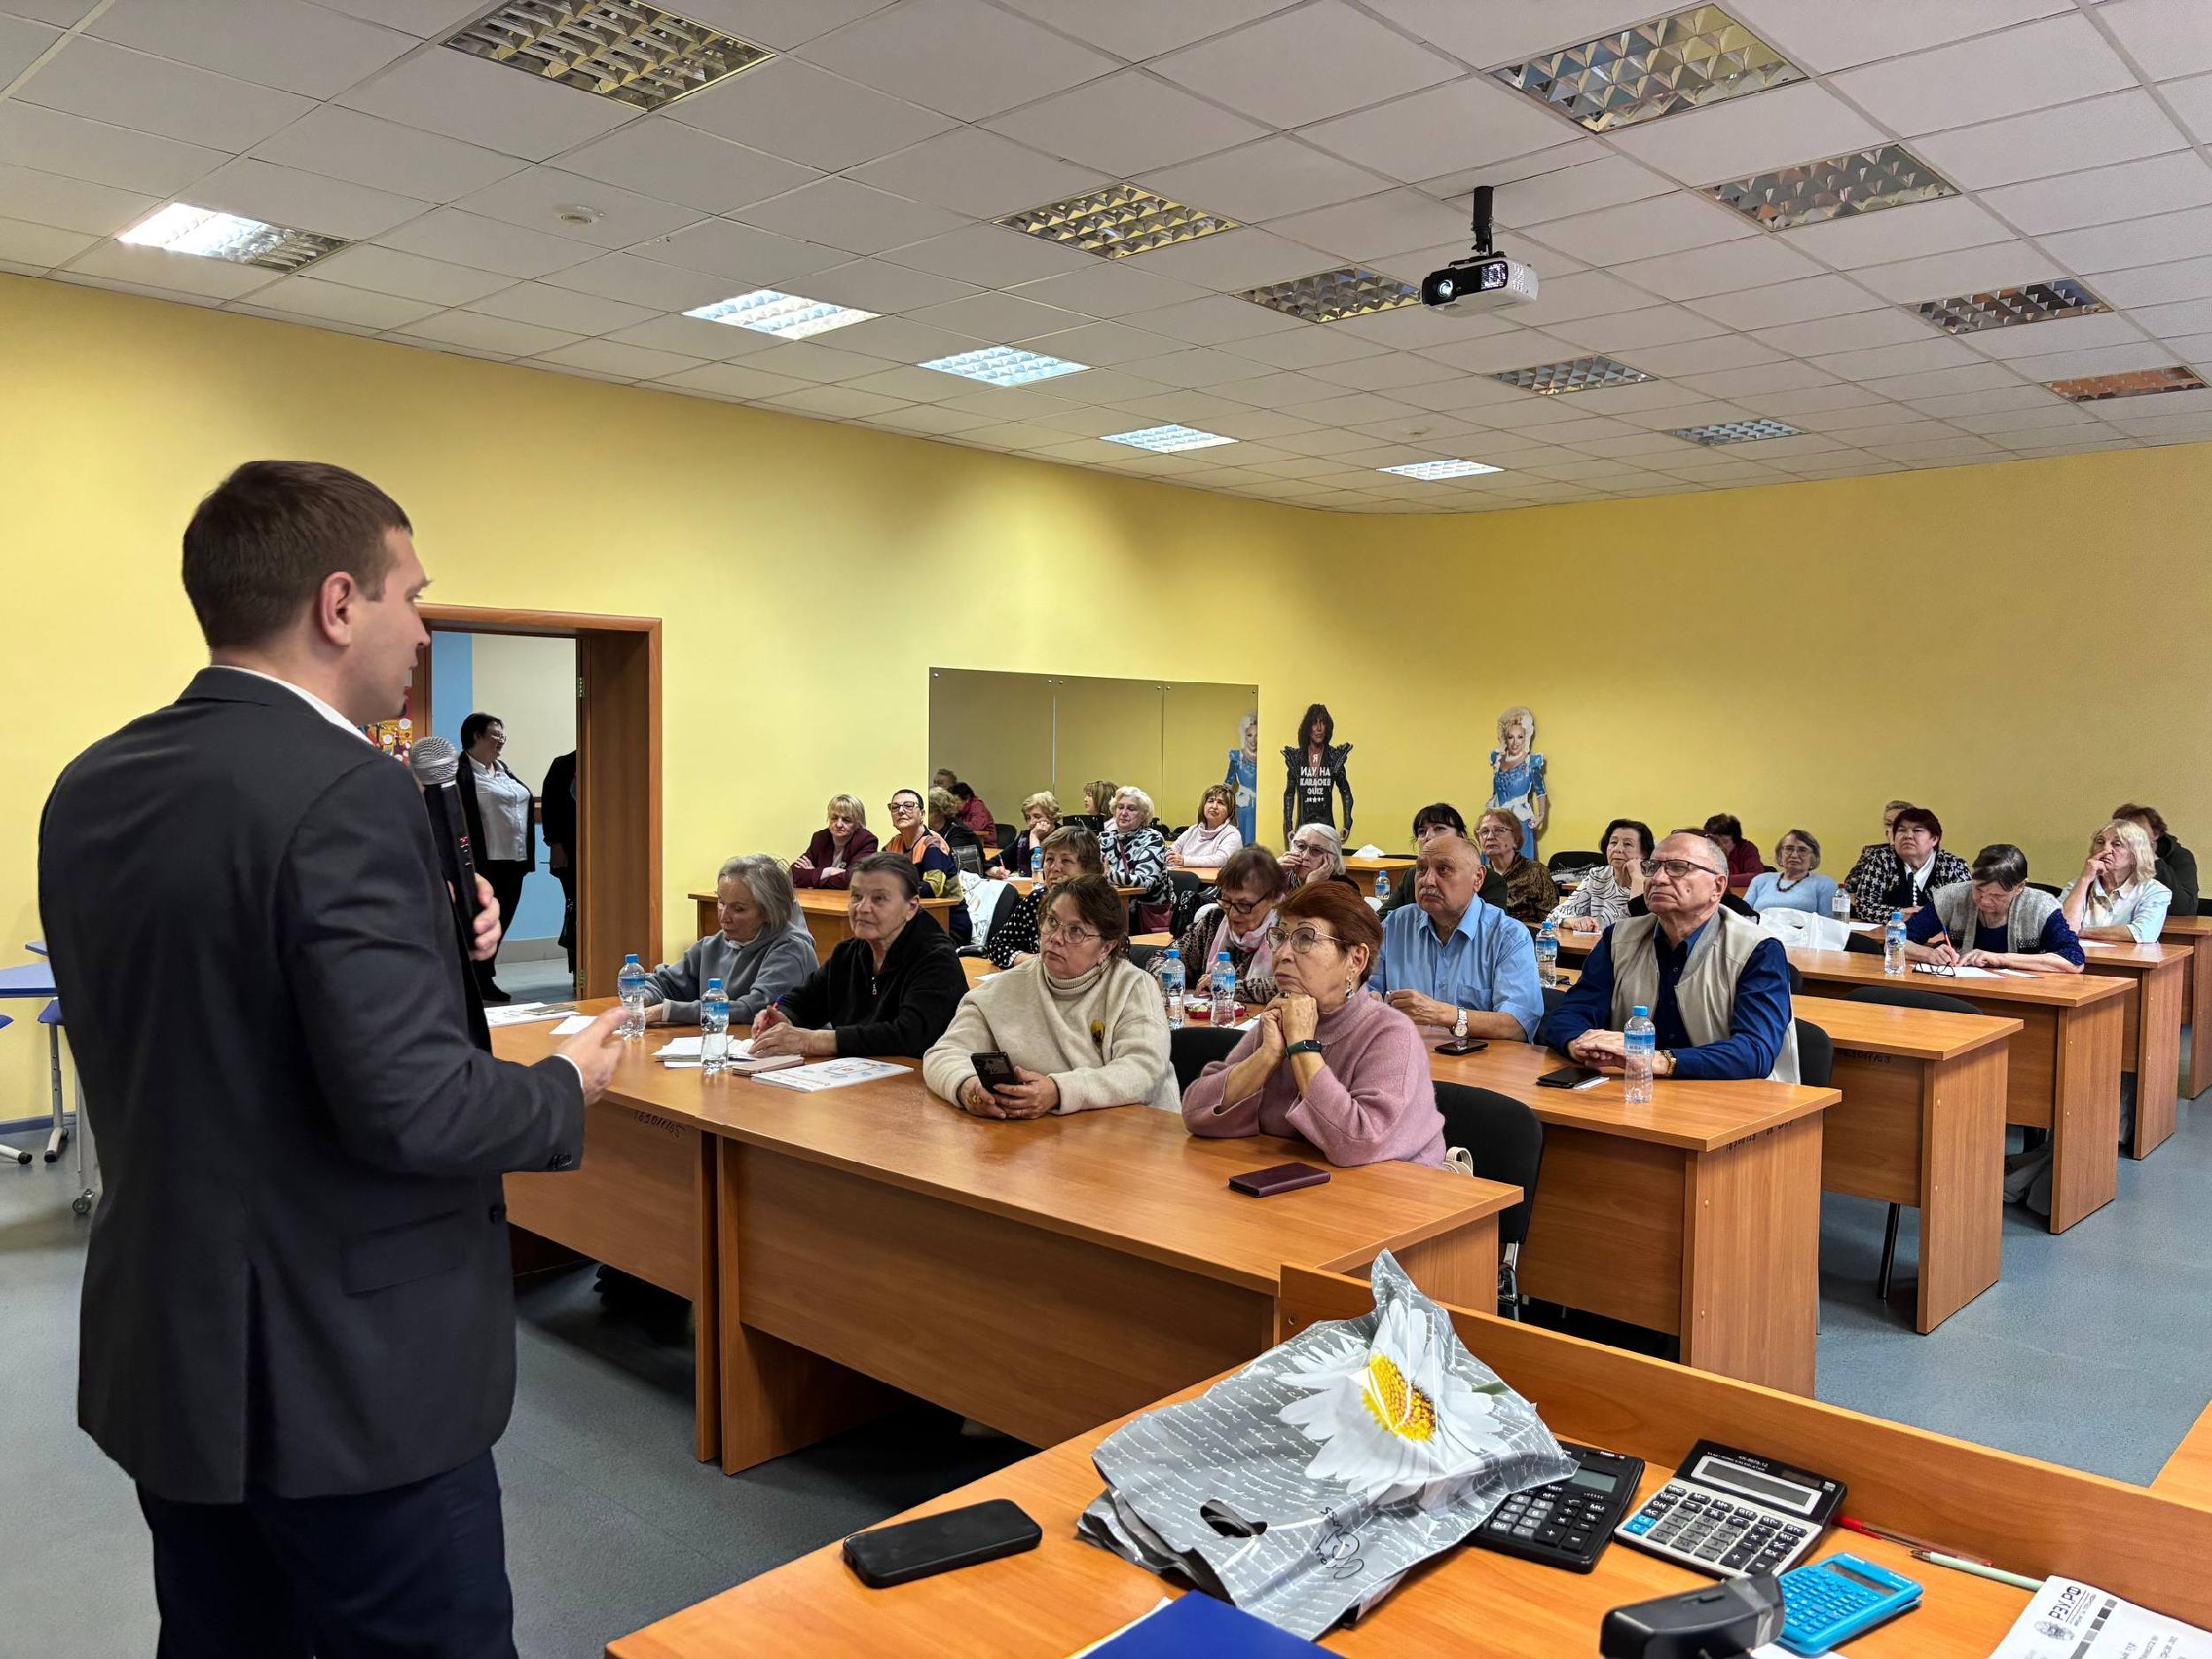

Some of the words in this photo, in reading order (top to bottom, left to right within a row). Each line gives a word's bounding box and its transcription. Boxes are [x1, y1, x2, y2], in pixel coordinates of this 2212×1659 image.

[1312, 754, 1318, 763] Я
[1301, 766, 1317, 777] ИДУ
[1319, 766, 1331, 777] НА
[1300, 778, 1332, 787] KARAOKE
